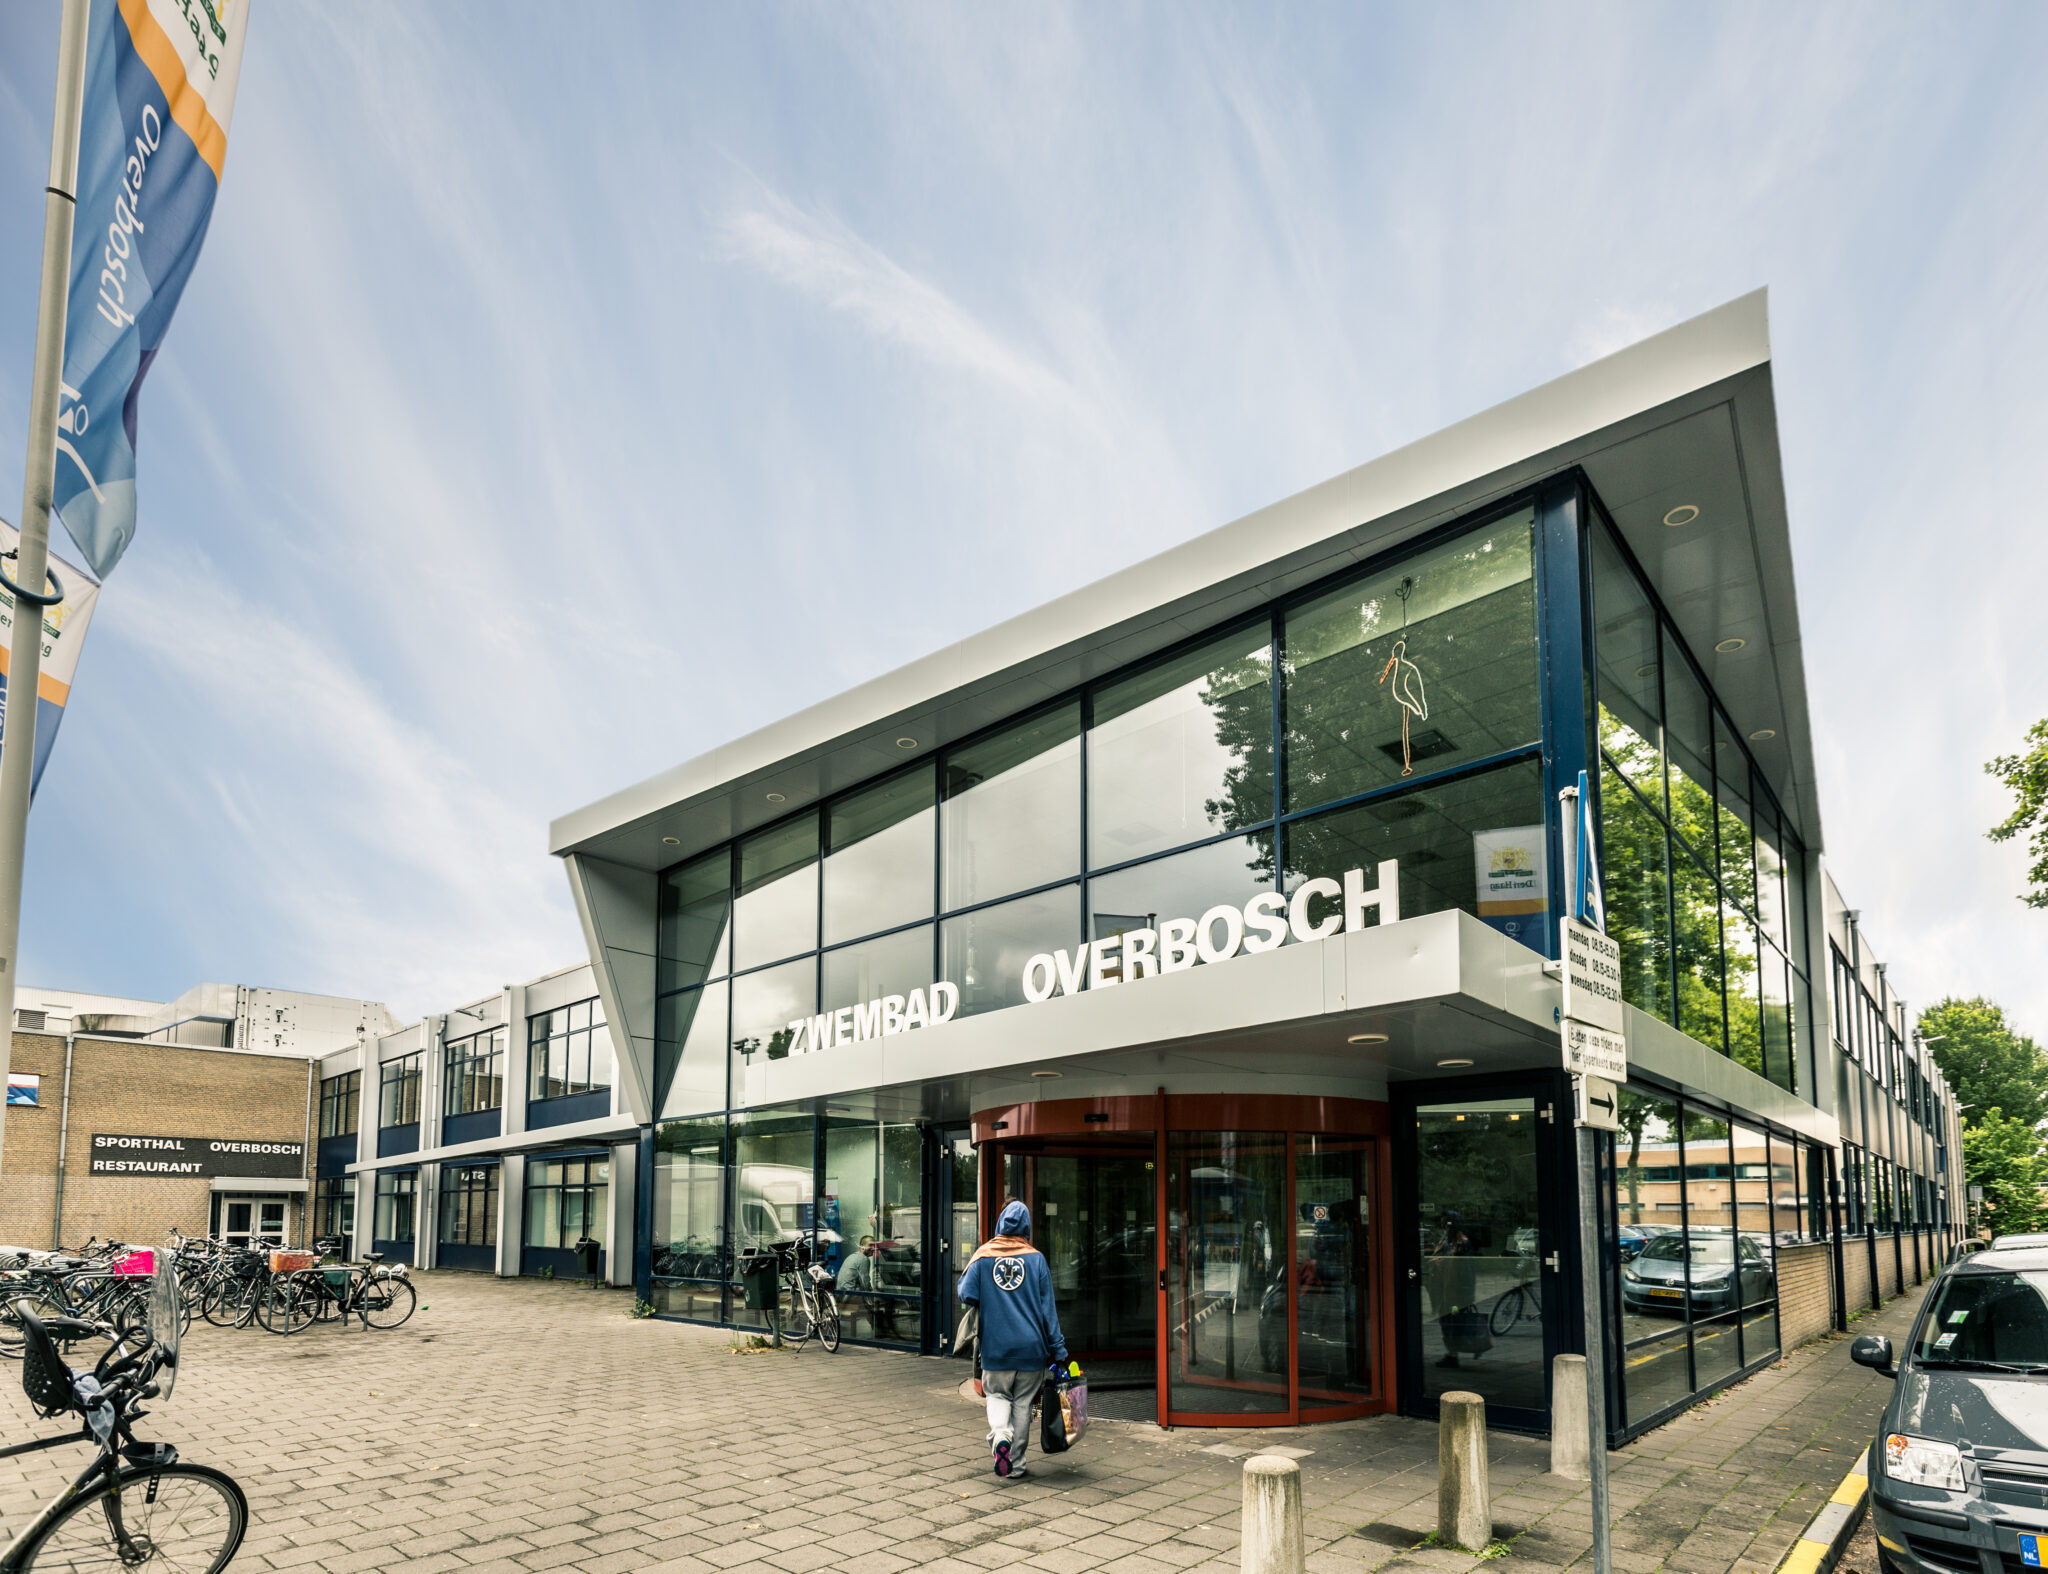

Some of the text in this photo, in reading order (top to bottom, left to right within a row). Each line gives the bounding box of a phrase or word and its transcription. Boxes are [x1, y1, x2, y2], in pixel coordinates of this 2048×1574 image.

[97, 104, 161, 328] Overbosch
[1569, 928, 1589, 951] maandag
[786, 858, 1400, 1056] ZWEMBAD OVERBOSCH
[1569, 948, 1587, 972] dinsdag
[1570, 974, 1593, 996] woensdag
[95, 1136, 301, 1155] SPORTHAL OVERBOSCH
[93, 1160, 203, 1173] RESTAURANT
[2023, 1551, 2038, 1561] NL
